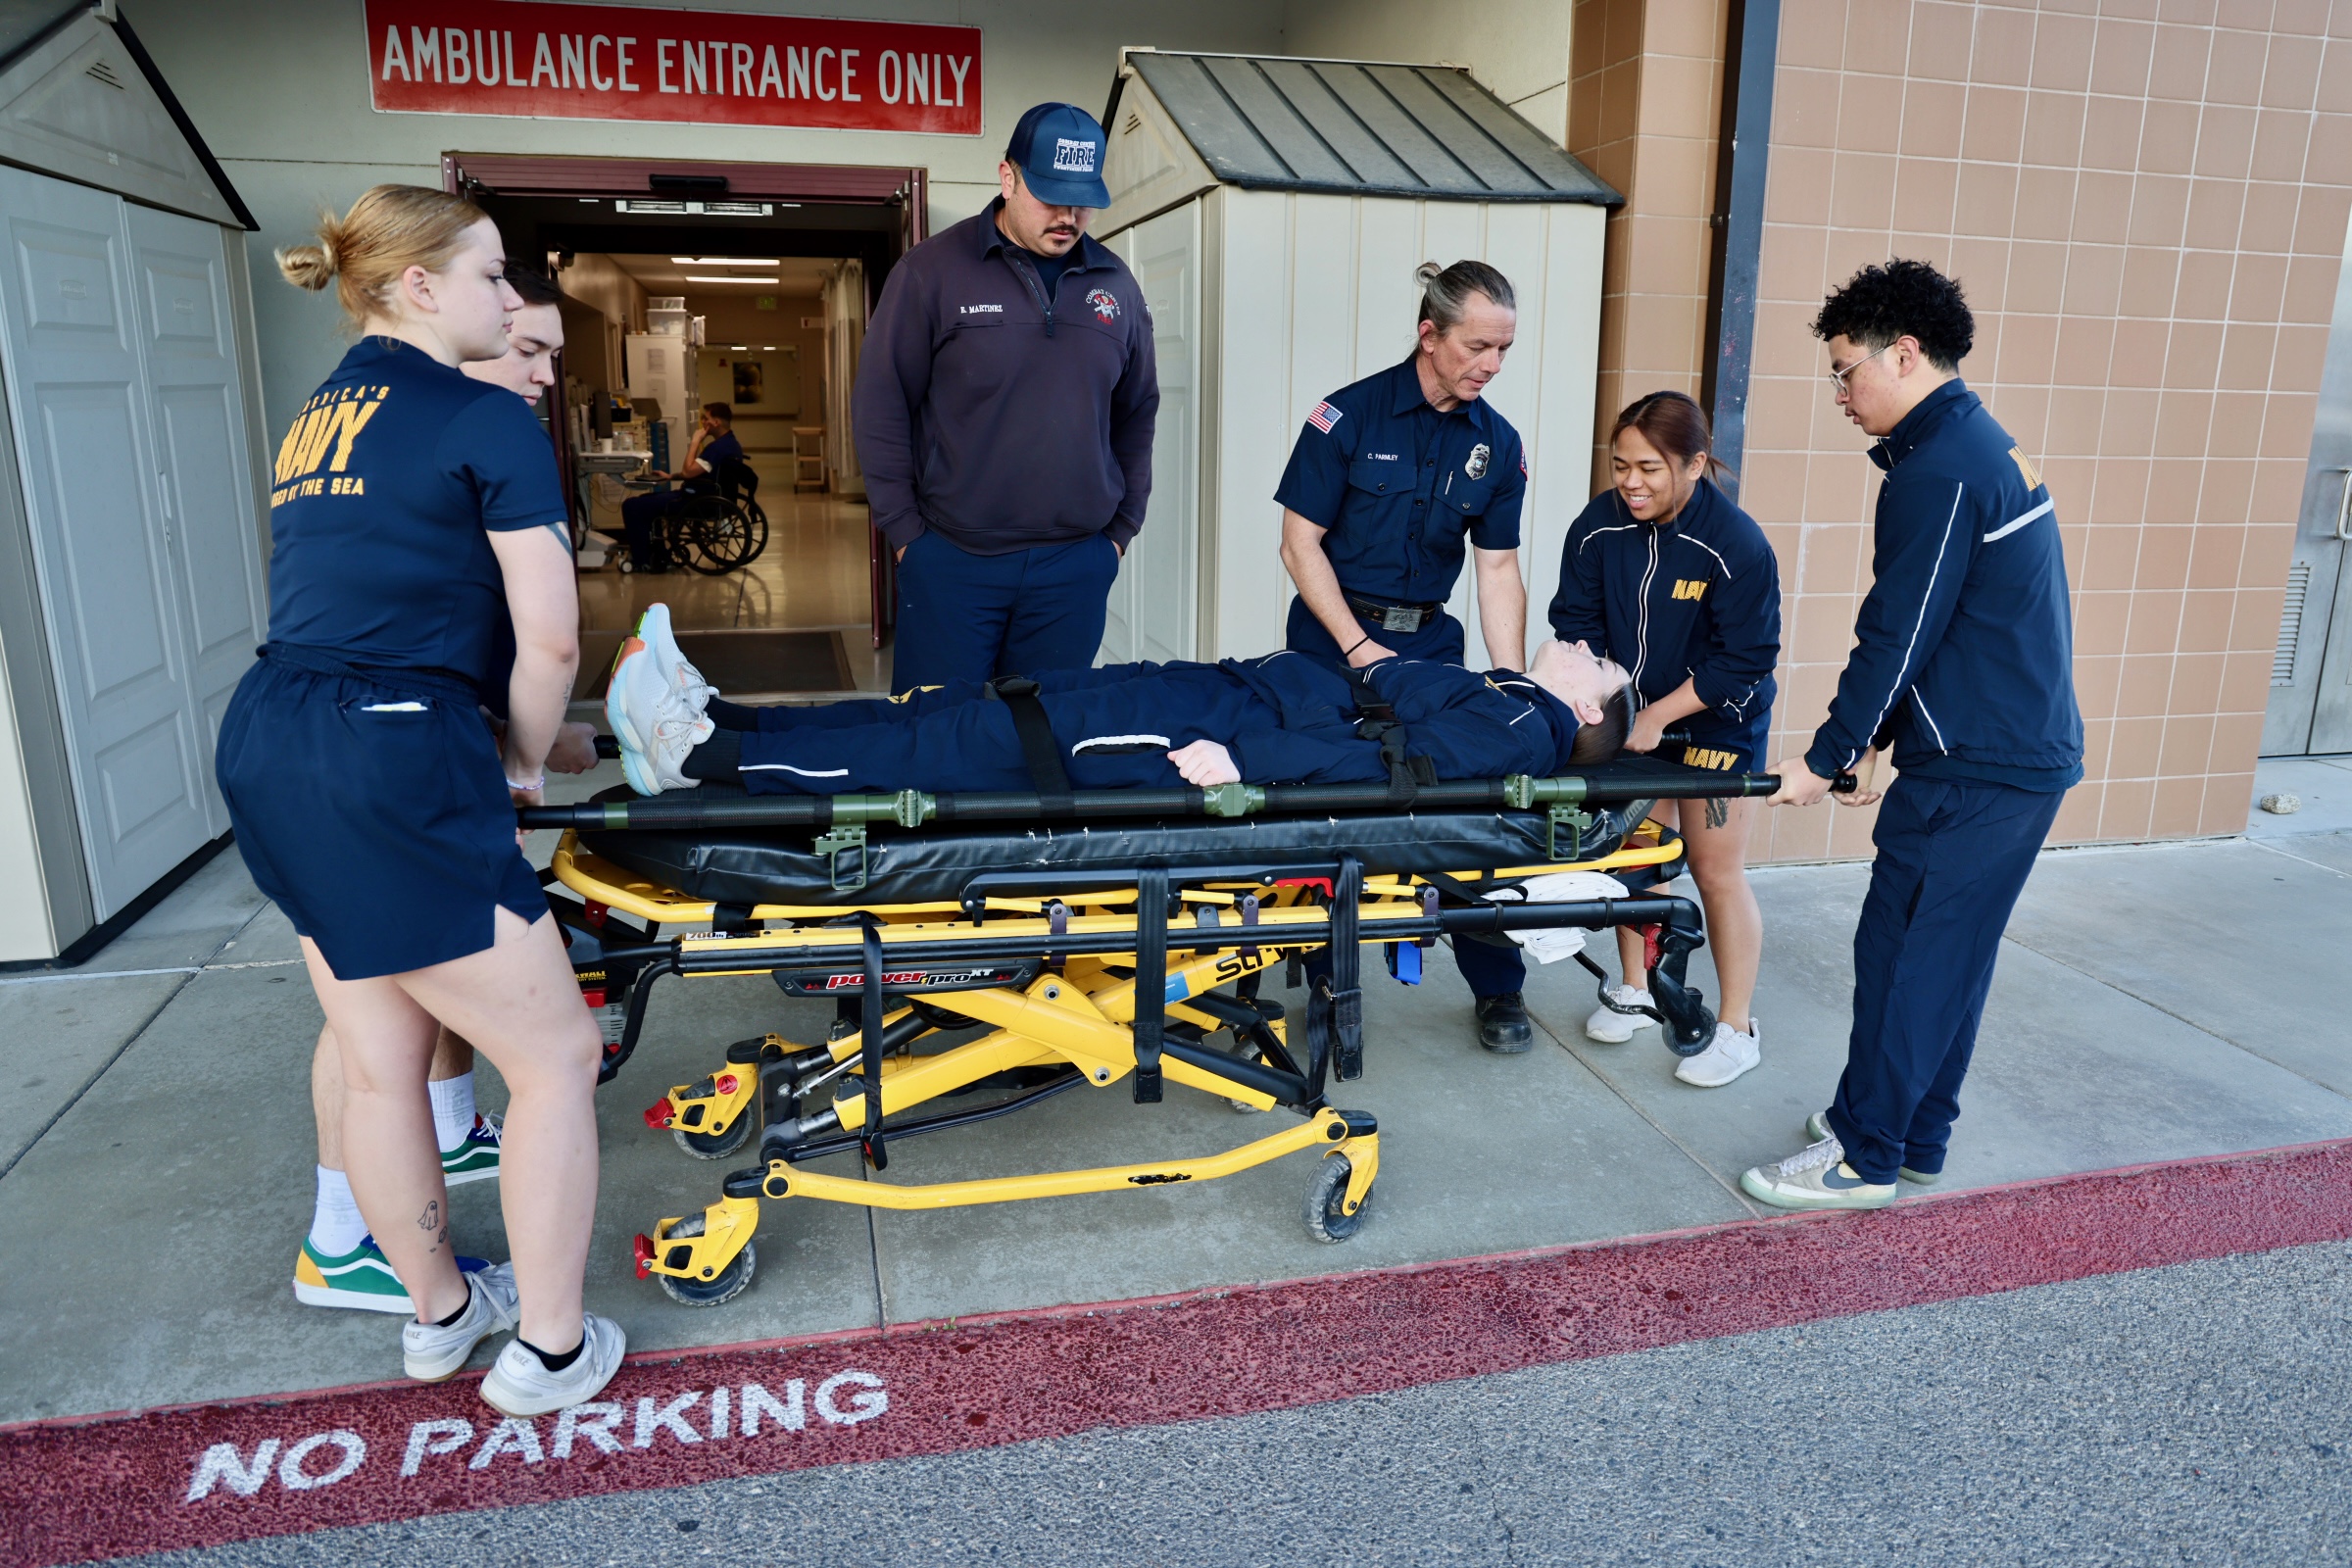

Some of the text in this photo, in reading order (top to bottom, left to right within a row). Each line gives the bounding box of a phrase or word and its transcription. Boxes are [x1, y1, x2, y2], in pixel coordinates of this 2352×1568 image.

[381, 24, 972, 107] AMBULANCE ENTRANCE ONLY
[1054, 144, 1096, 167] FIRE
[968, 304, 1004, 314] MARTINEZ
[1085, 288, 1104, 304] COMBAT
[1104, 291, 1121, 316] CENTER
[297, 385, 390, 418] ERICA'S
[274, 401, 381, 487] NAVY
[300, 478, 324, 497] THE
[330, 477, 364, 495] SEA
[1683, 746, 1740, 771] NAVY
[970, 968, 994, 977] XT
[405, 1331, 422, 1340] NIKE
[511, 1350, 532, 1367] NIKE
[187, 1371, 888, 1501] NO PARKING
